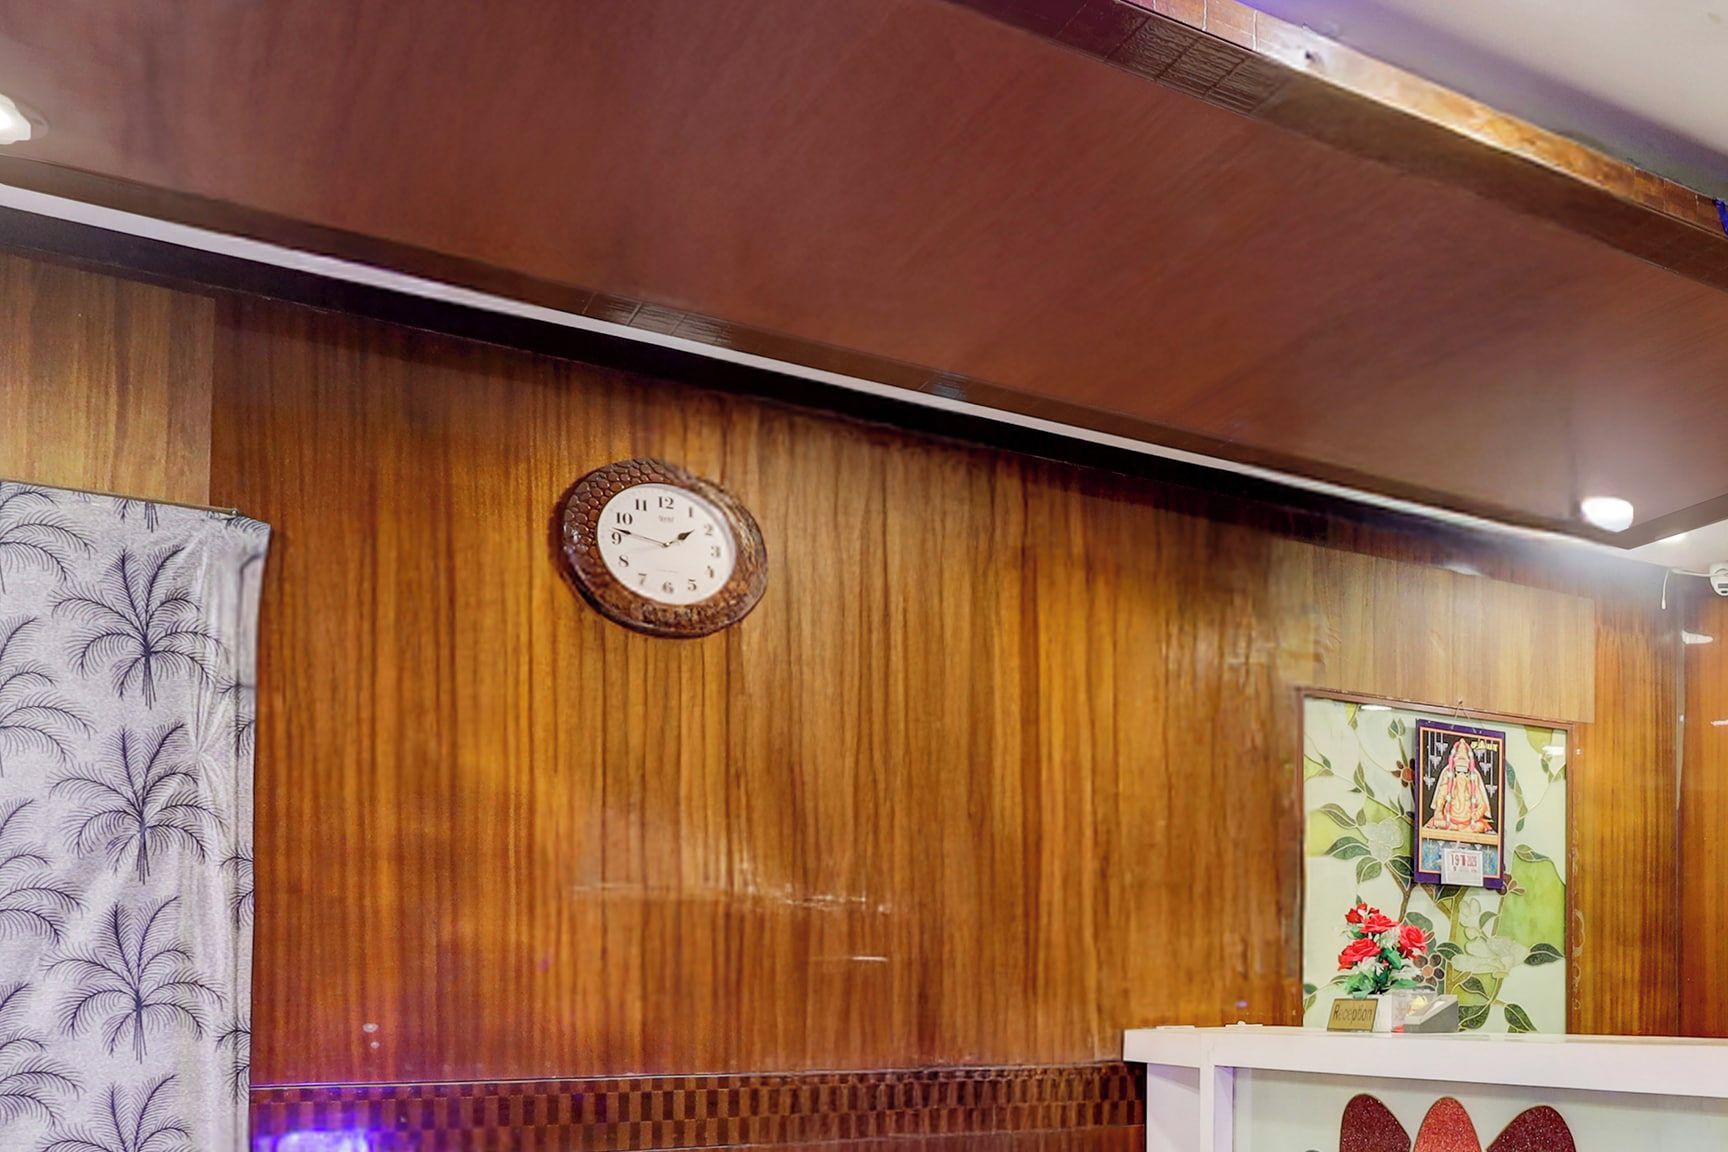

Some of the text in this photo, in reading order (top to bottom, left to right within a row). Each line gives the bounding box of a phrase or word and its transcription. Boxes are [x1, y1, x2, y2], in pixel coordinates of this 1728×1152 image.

[635, 499, 647, 511] 11
[658, 496, 674, 510] 12
[616, 512, 633, 525] 10
[688, 506, 693, 518] 1
[703, 523, 713, 537] 2
[611, 531, 622, 545] 9
[710, 546, 720, 558] 3
[618, 554, 629, 568] 8
[705, 565, 714, 578] 4
[638, 572, 648, 586] 7
[687, 578, 697, 591] 5
[662, 580, 674, 594] 6
